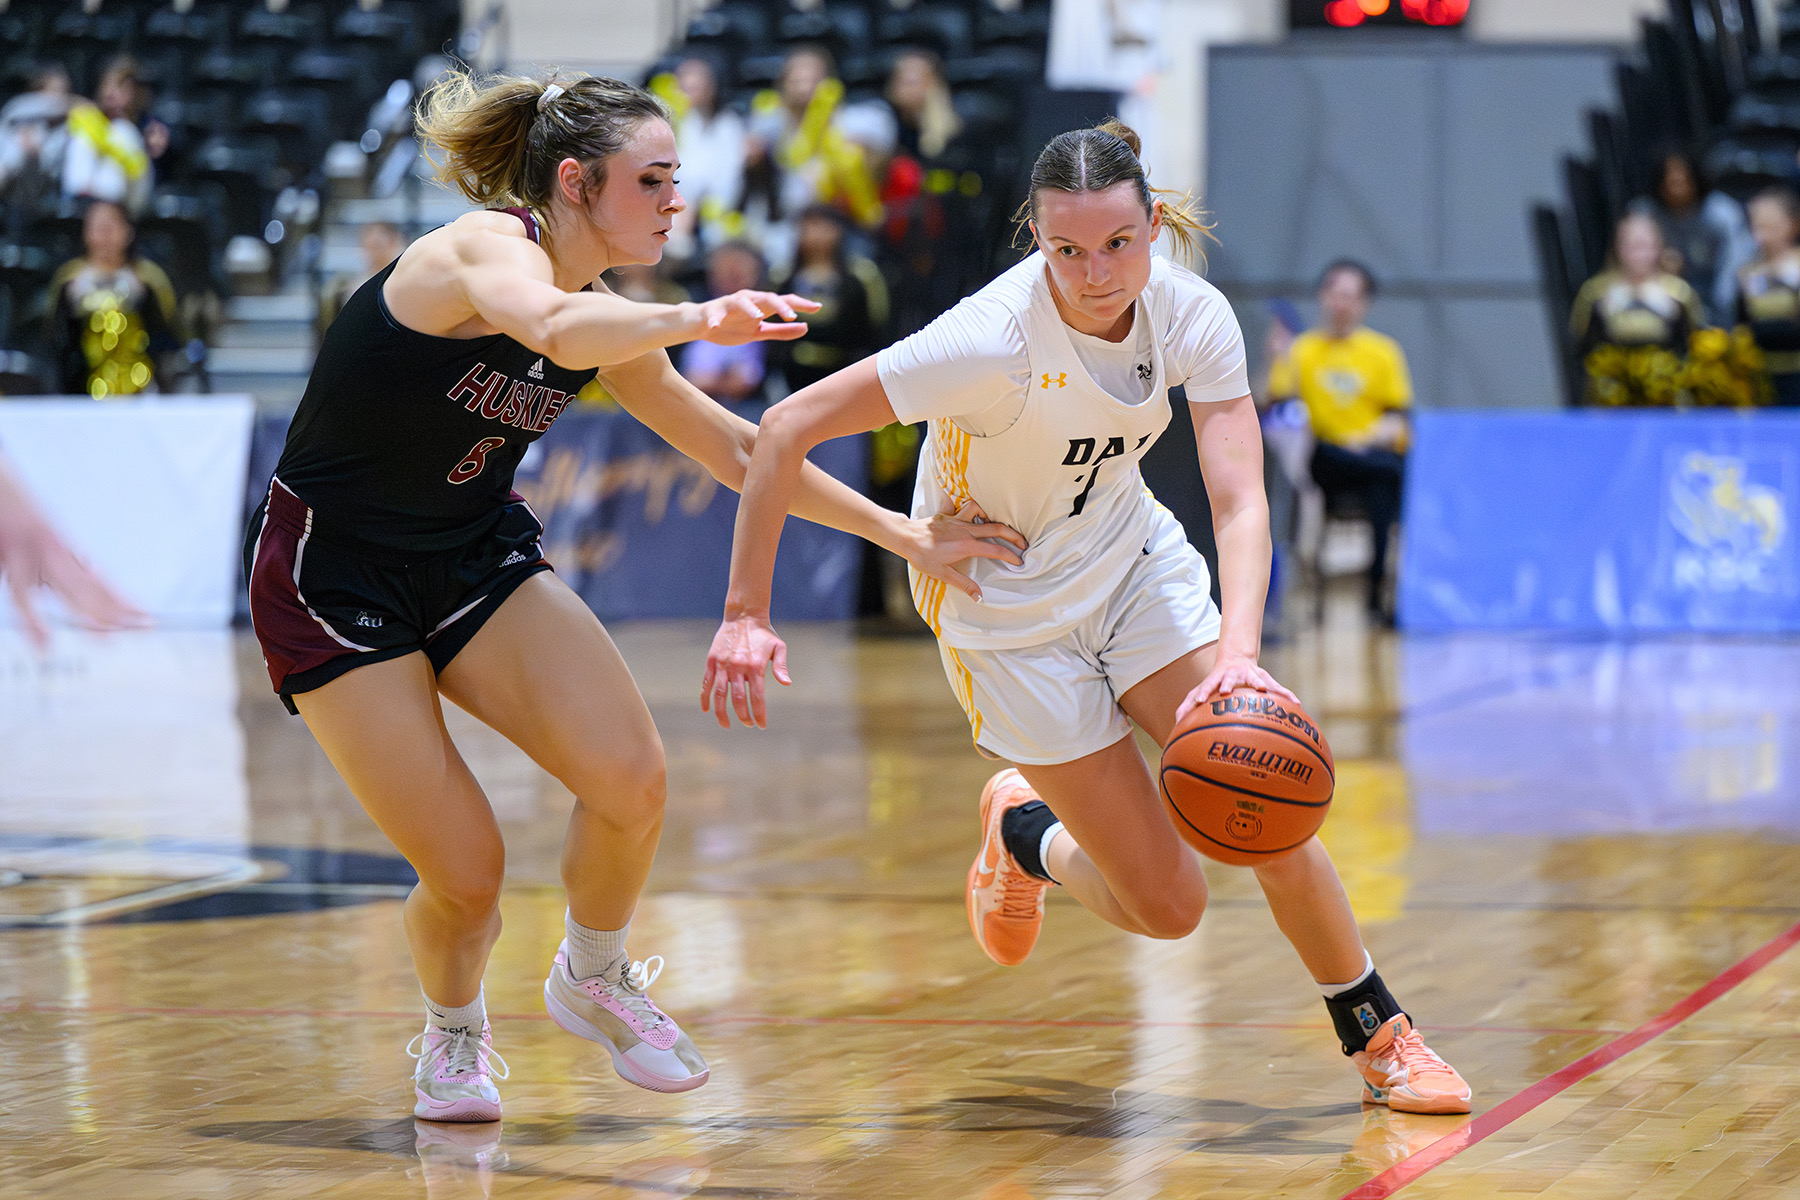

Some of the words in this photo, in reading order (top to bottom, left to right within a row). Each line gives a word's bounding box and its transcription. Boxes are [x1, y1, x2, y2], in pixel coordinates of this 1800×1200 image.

[527, 369, 545, 380] adidas
[447, 436, 506, 485] 8
[1061, 432, 1153, 466] DA
[1210, 695, 1321, 746] Wilson
[1207, 741, 1313, 782] EVOLUTION
